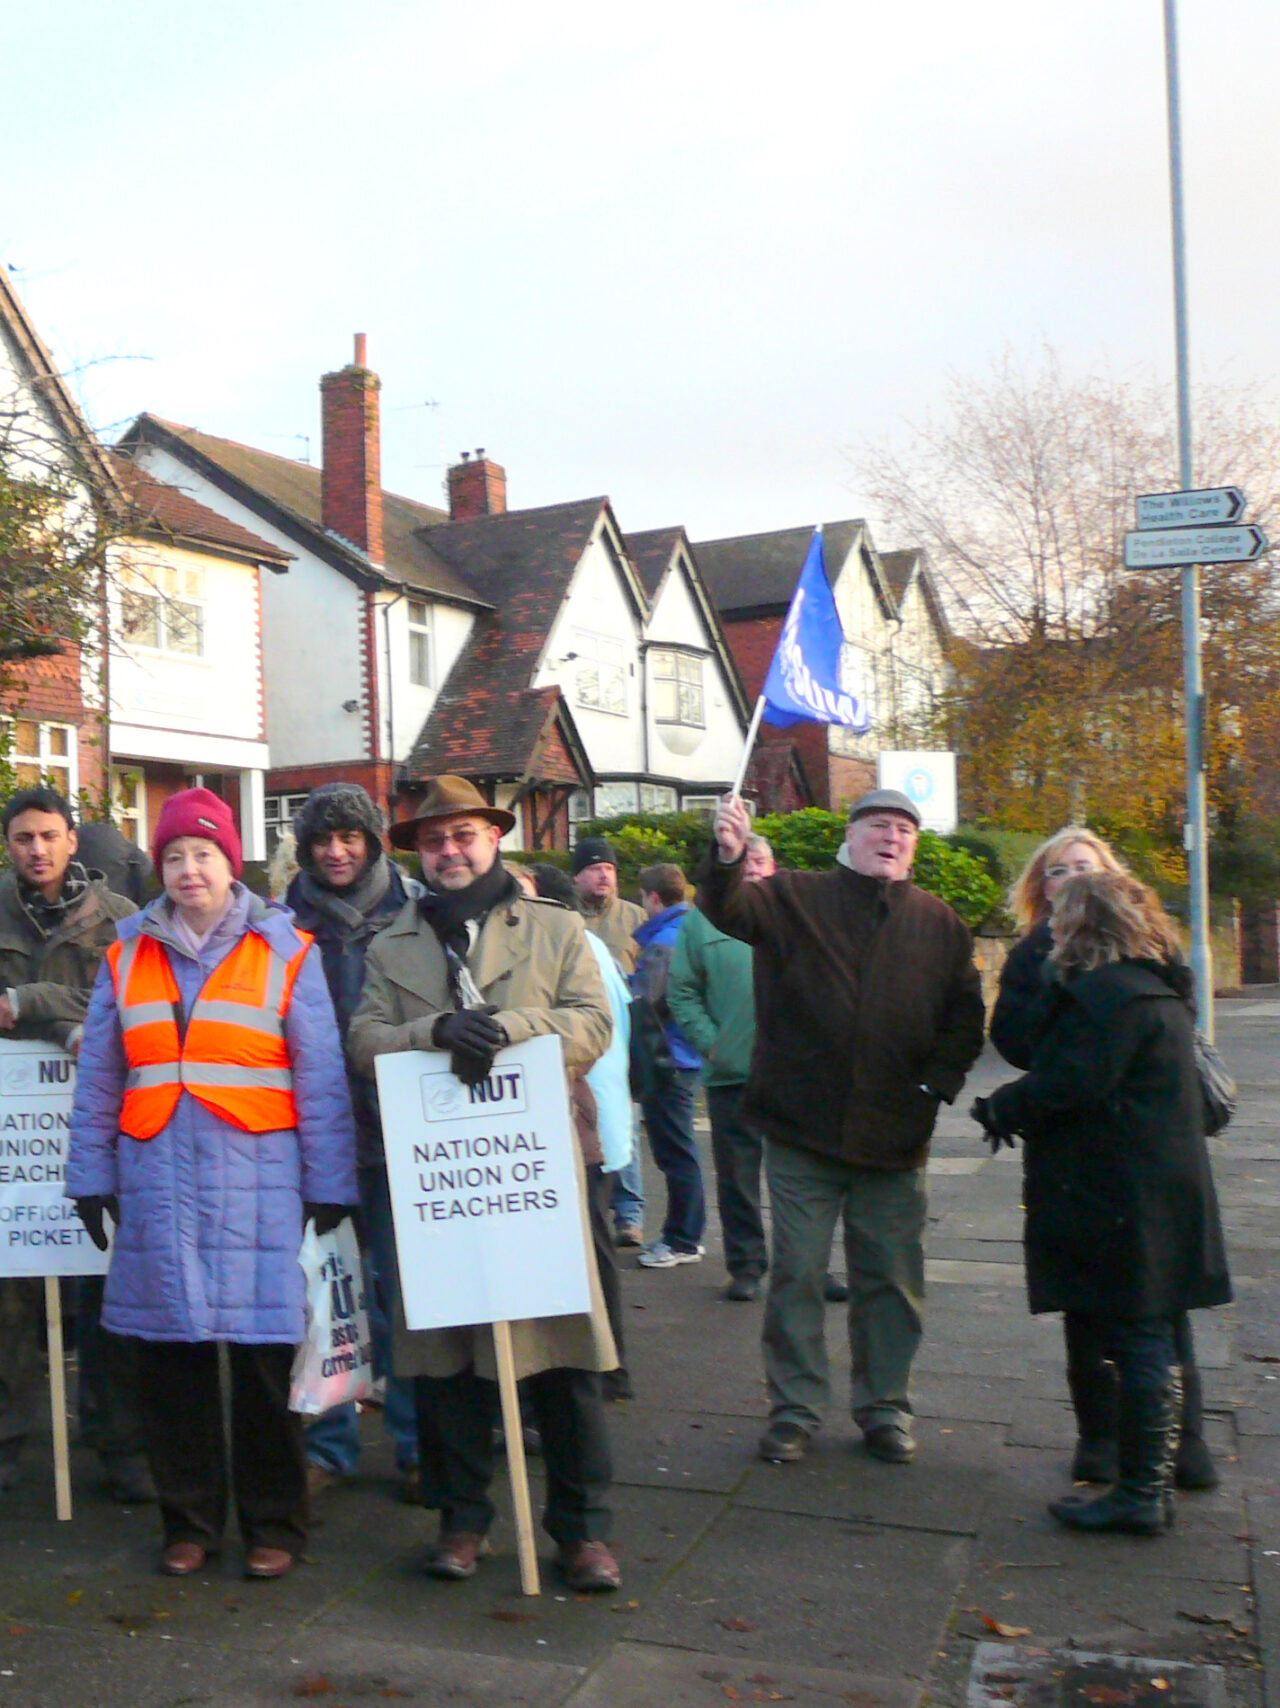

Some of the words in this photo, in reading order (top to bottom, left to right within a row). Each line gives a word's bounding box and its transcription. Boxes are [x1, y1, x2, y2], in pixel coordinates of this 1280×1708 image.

[1140, 500, 1164, 509] The
[1141, 511, 1184, 522] Health
[1187, 508, 1219, 519] Care
[1195, 535, 1241, 545] College
[38, 1059, 78, 1084] NU
[469, 1073, 520, 1104] NUT
[412, 1130, 548, 1164] NATIONAL
[418, 1164, 503, 1192] UNION
[510, 1160, 546, 1183] OF
[413, 1188, 559, 1222] TEACHERS
[8, 1228, 87, 1247] PICKET
